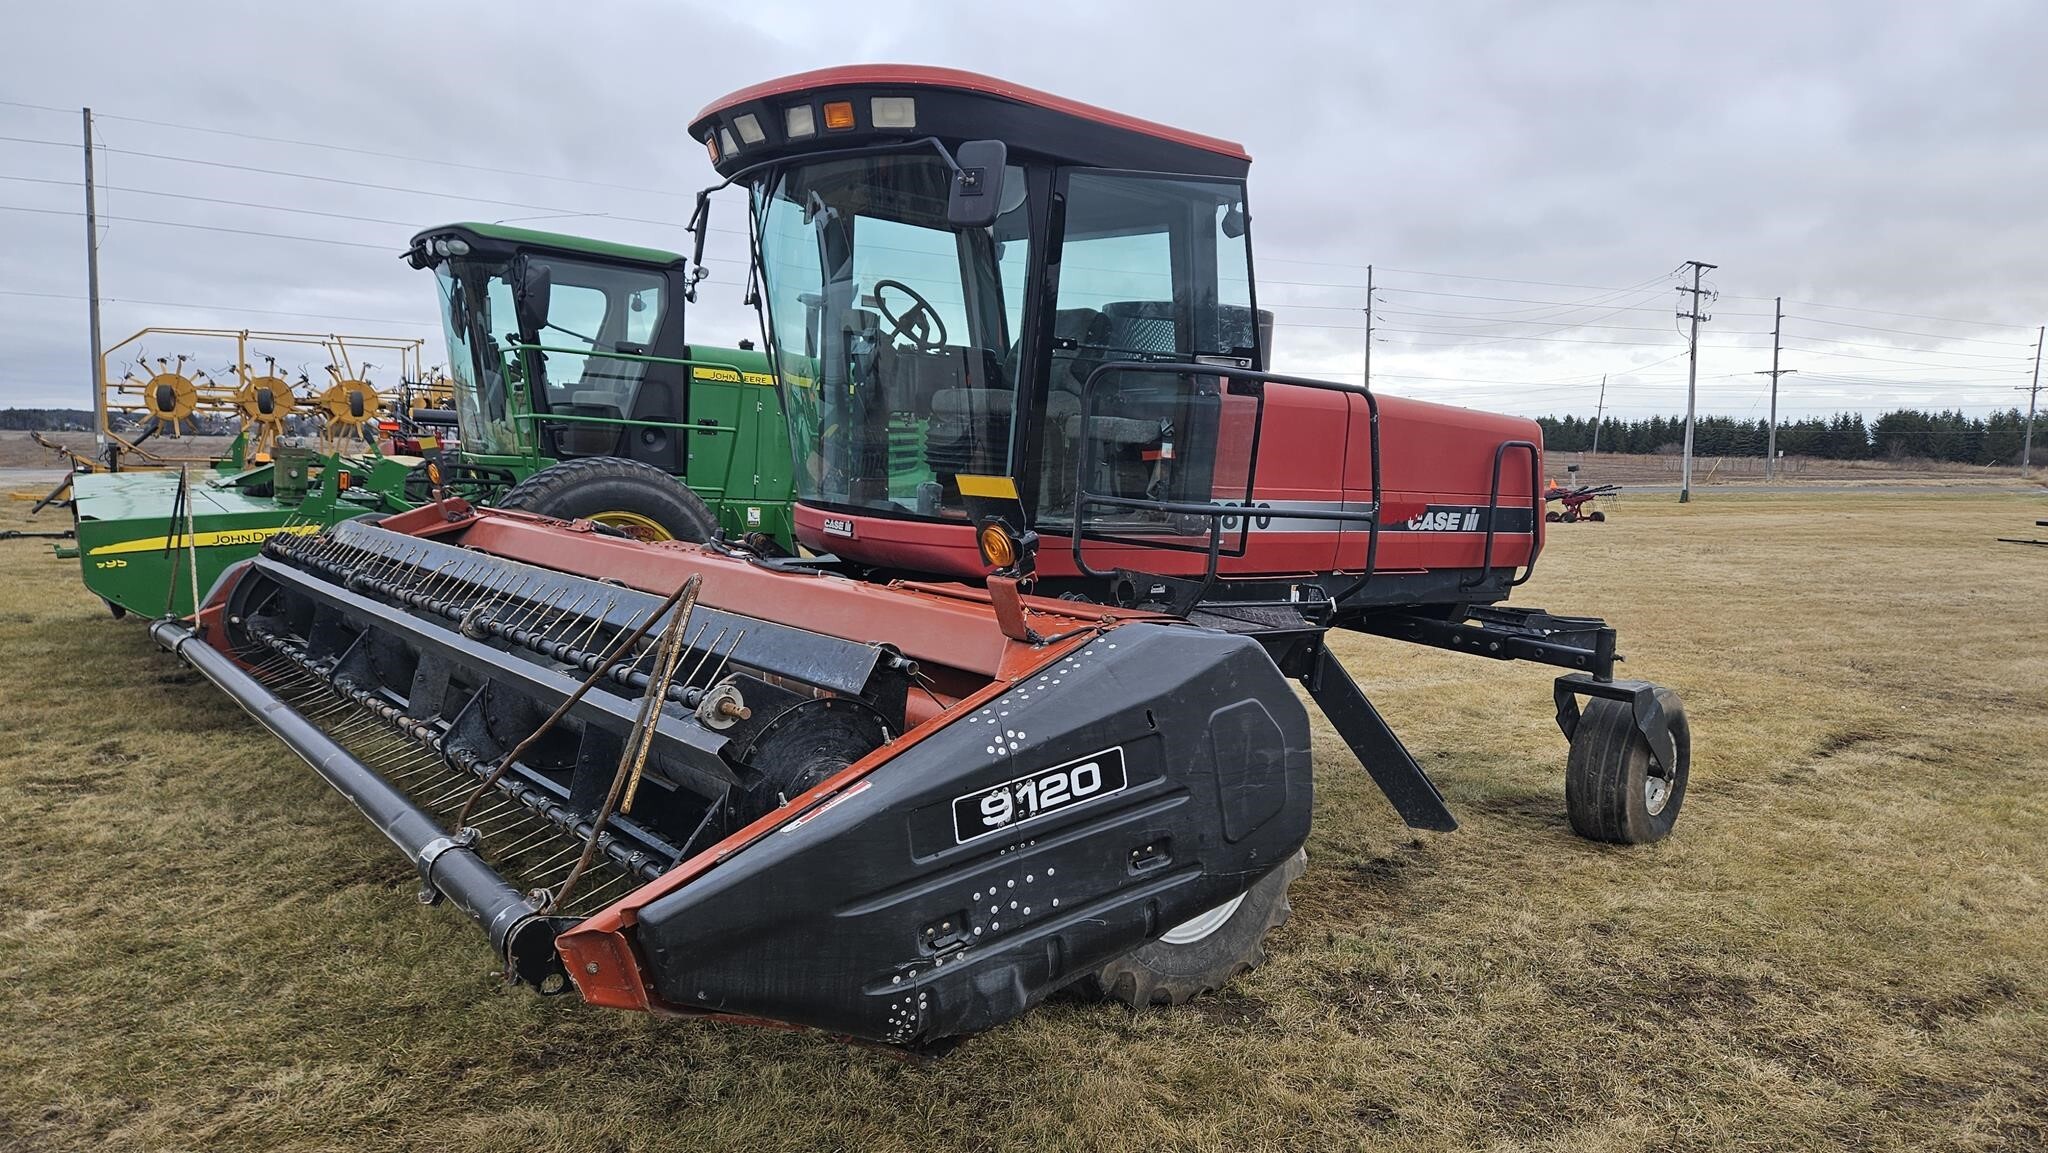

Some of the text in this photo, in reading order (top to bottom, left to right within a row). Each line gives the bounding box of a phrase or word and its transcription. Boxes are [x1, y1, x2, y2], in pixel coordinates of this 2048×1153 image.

[711, 371, 735, 380] JOHN
[824, 518, 844, 531] CASE
[1407, 511, 1461, 531] CASE
[212, 533, 250, 545] JOHN
[980, 761, 1102, 826] 9120
